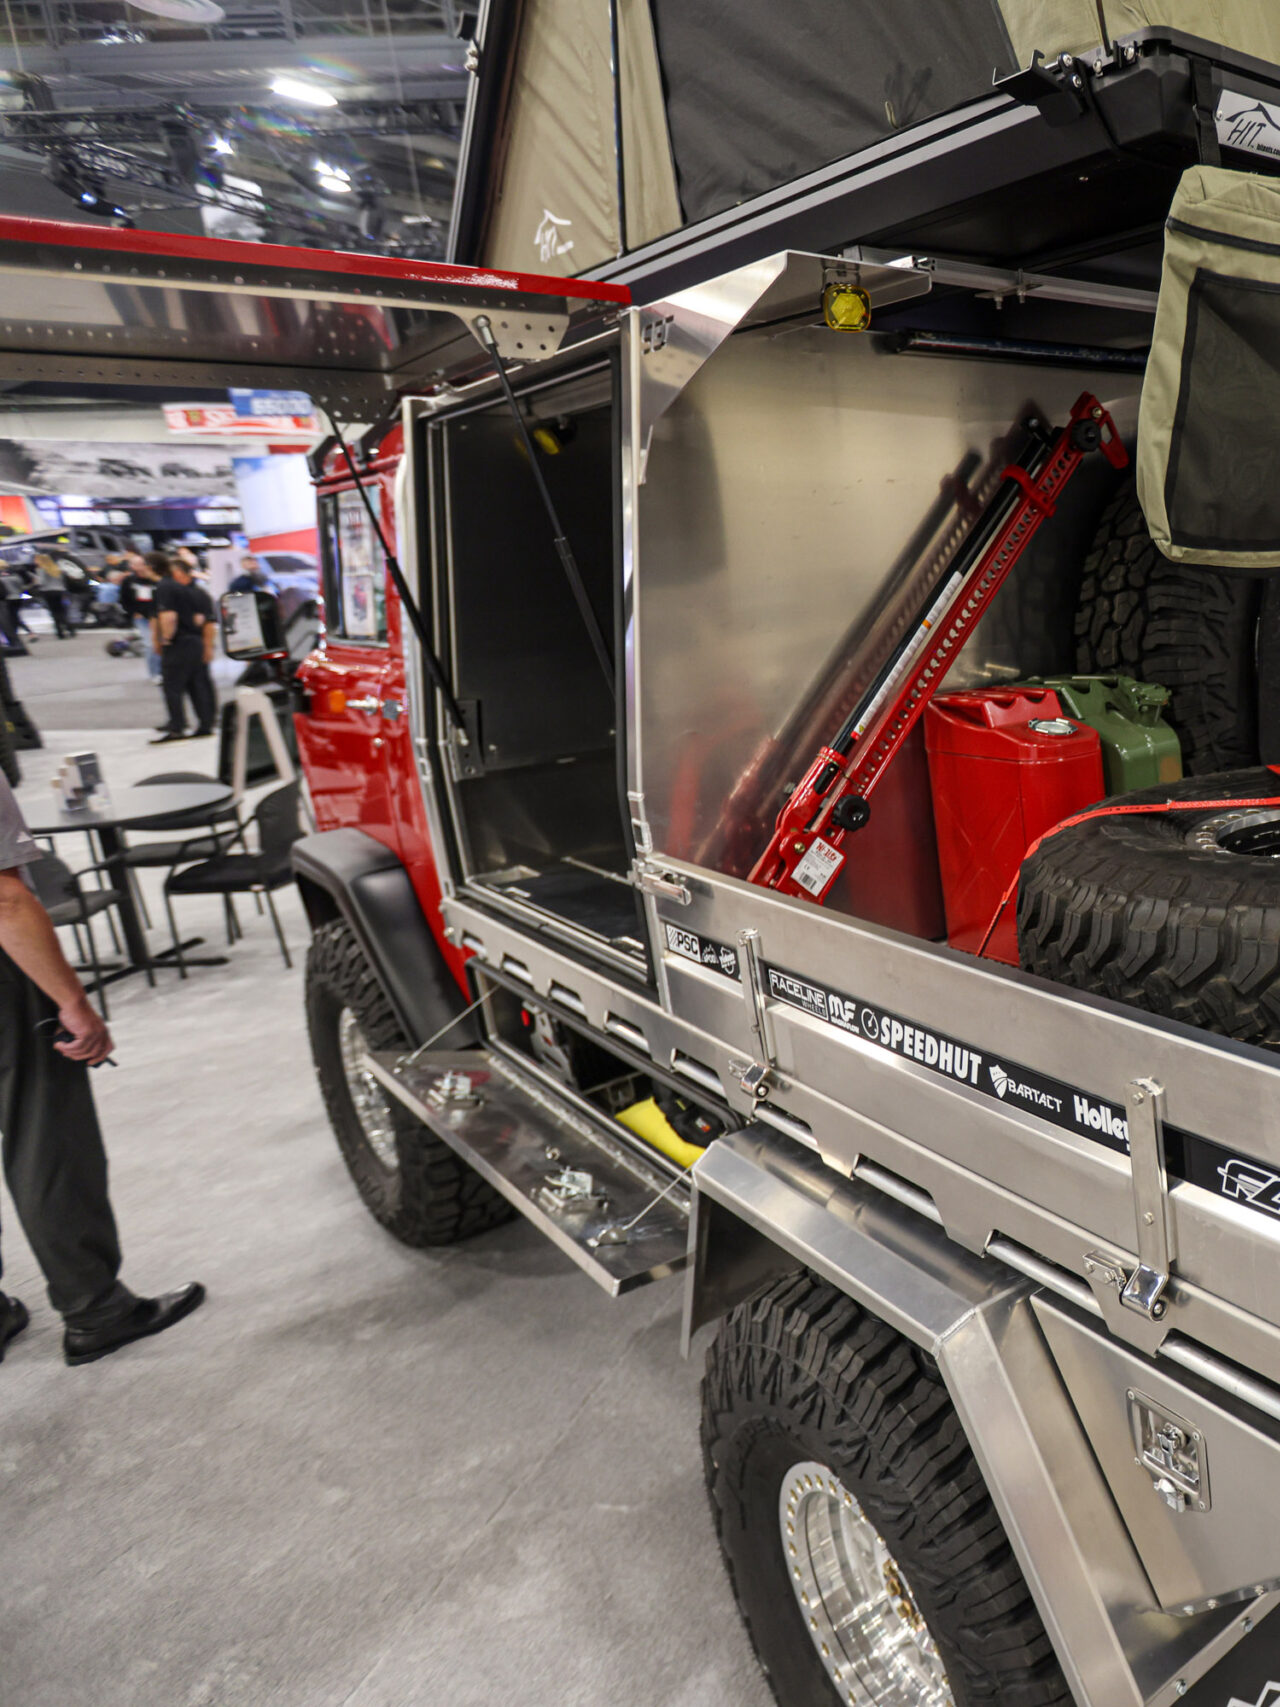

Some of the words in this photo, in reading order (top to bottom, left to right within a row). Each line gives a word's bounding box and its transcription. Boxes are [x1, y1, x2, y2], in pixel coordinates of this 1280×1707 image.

[676, 931, 699, 955] PSC
[770, 973, 826, 1009] RACELINE
[801, 1000, 827, 1017] WHEELS
[880, 1015, 983, 1085] SPEEDHUT
[1006, 1077, 1063, 1113] BARTACT
